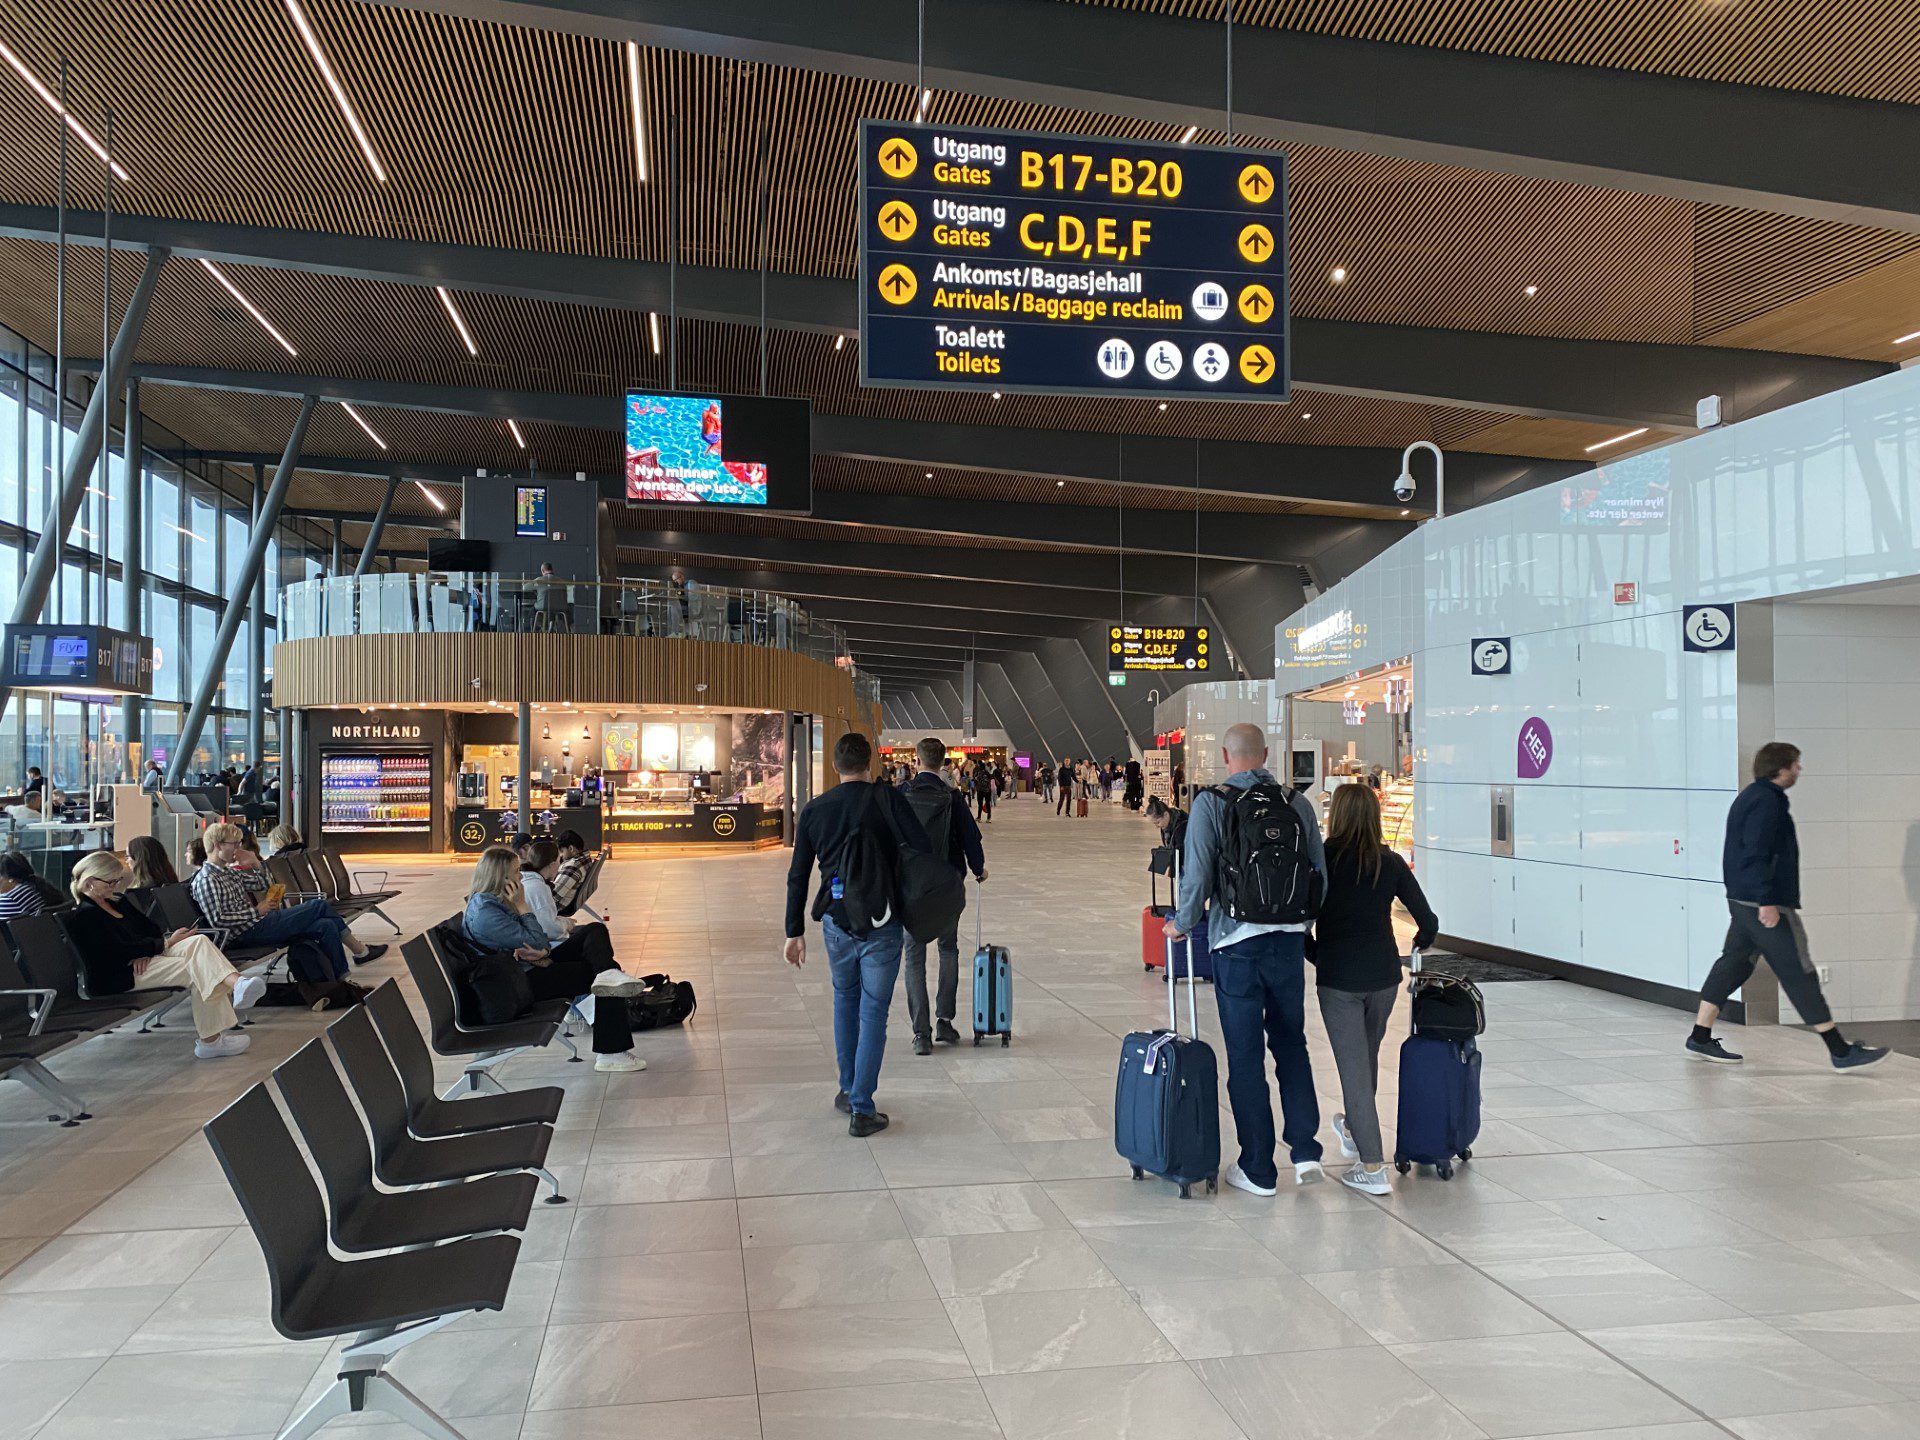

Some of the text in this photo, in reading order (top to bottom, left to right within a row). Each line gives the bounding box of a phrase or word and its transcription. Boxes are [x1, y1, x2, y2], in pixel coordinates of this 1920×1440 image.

[933, 136, 1006, 166] Utgang
[933, 162, 991, 185] Gates
[1021, 150, 1183, 198] B17-B20
[933, 198, 1006, 228] Utgang
[933, 224, 991, 247] Gates
[1019, 213, 1151, 261] C,D,E,F
[932, 262, 1142, 295] Ankomst/Bagasjehall
[1112, 298, 1183, 320] reclaim
[935, 325, 1005, 349] Toalett
[935, 351, 1001, 374] Toilets
[634, 464, 719, 480] Nye minner
[634, 481, 743, 494] venter der ute.
[1144, 628, 1185, 640] B18-B20
[98, 648, 112, 667] B17
[1144, 643, 1178, 656] C,D,E,F
[141, 657, 153, 674] B17
[332, 725, 421, 738] NORTHLAND
[1525, 726, 1547, 766] HER
[620, 823, 644, 831] TRACK
[645, 822, 664, 831] FOOD
